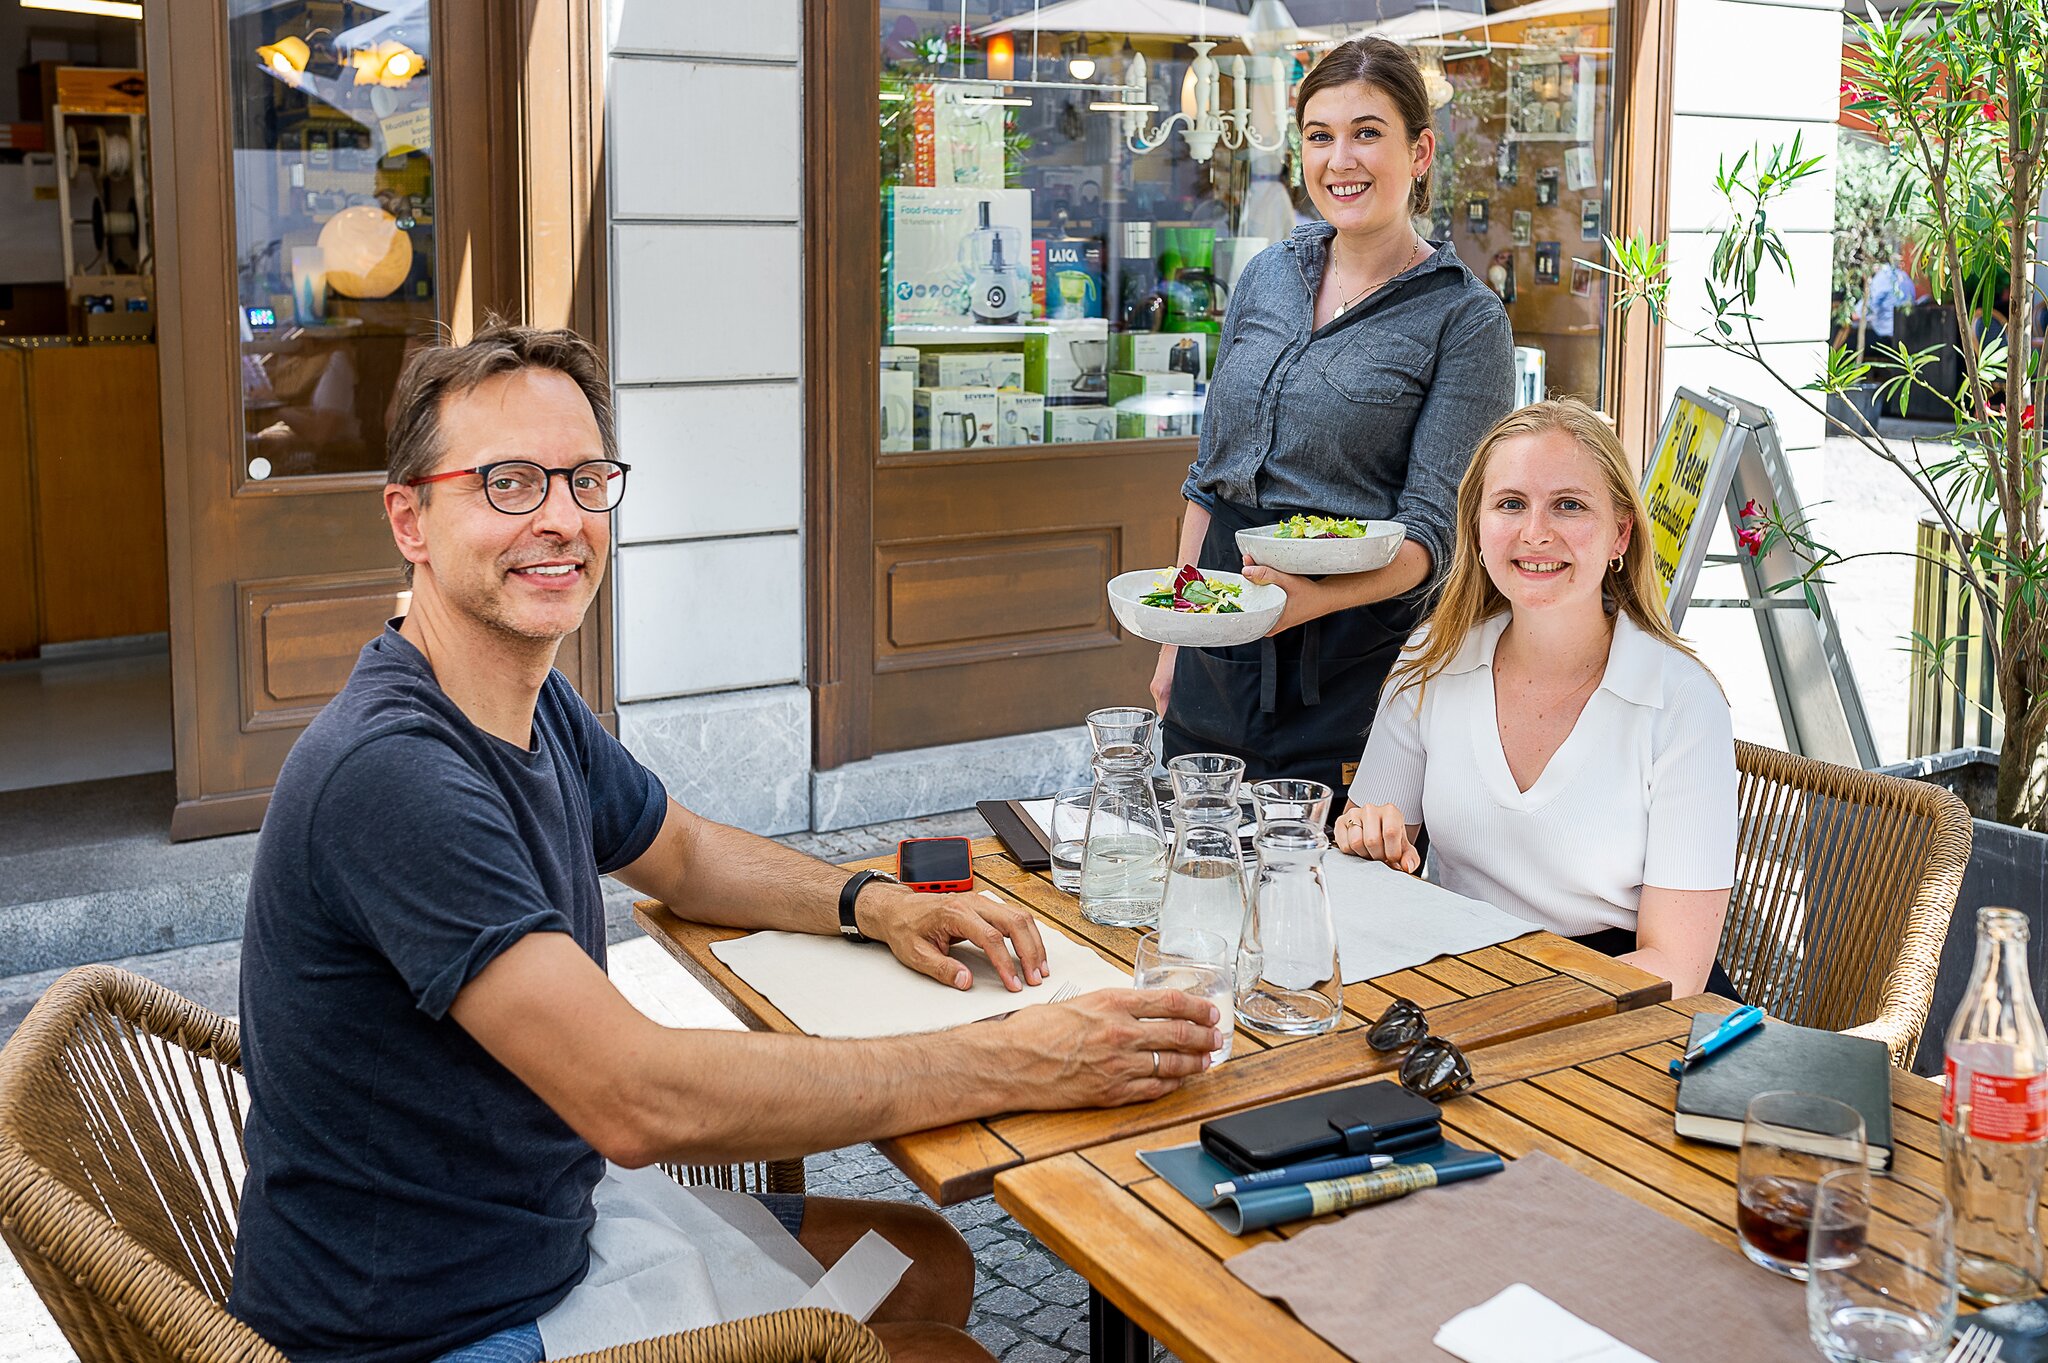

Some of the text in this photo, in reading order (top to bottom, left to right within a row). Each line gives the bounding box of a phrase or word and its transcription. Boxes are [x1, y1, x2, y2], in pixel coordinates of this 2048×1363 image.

[901, 204, 962, 215] Food Processor
[1049, 248, 1079, 262] LAICA
[965, 393, 995, 401] SEVERIN
